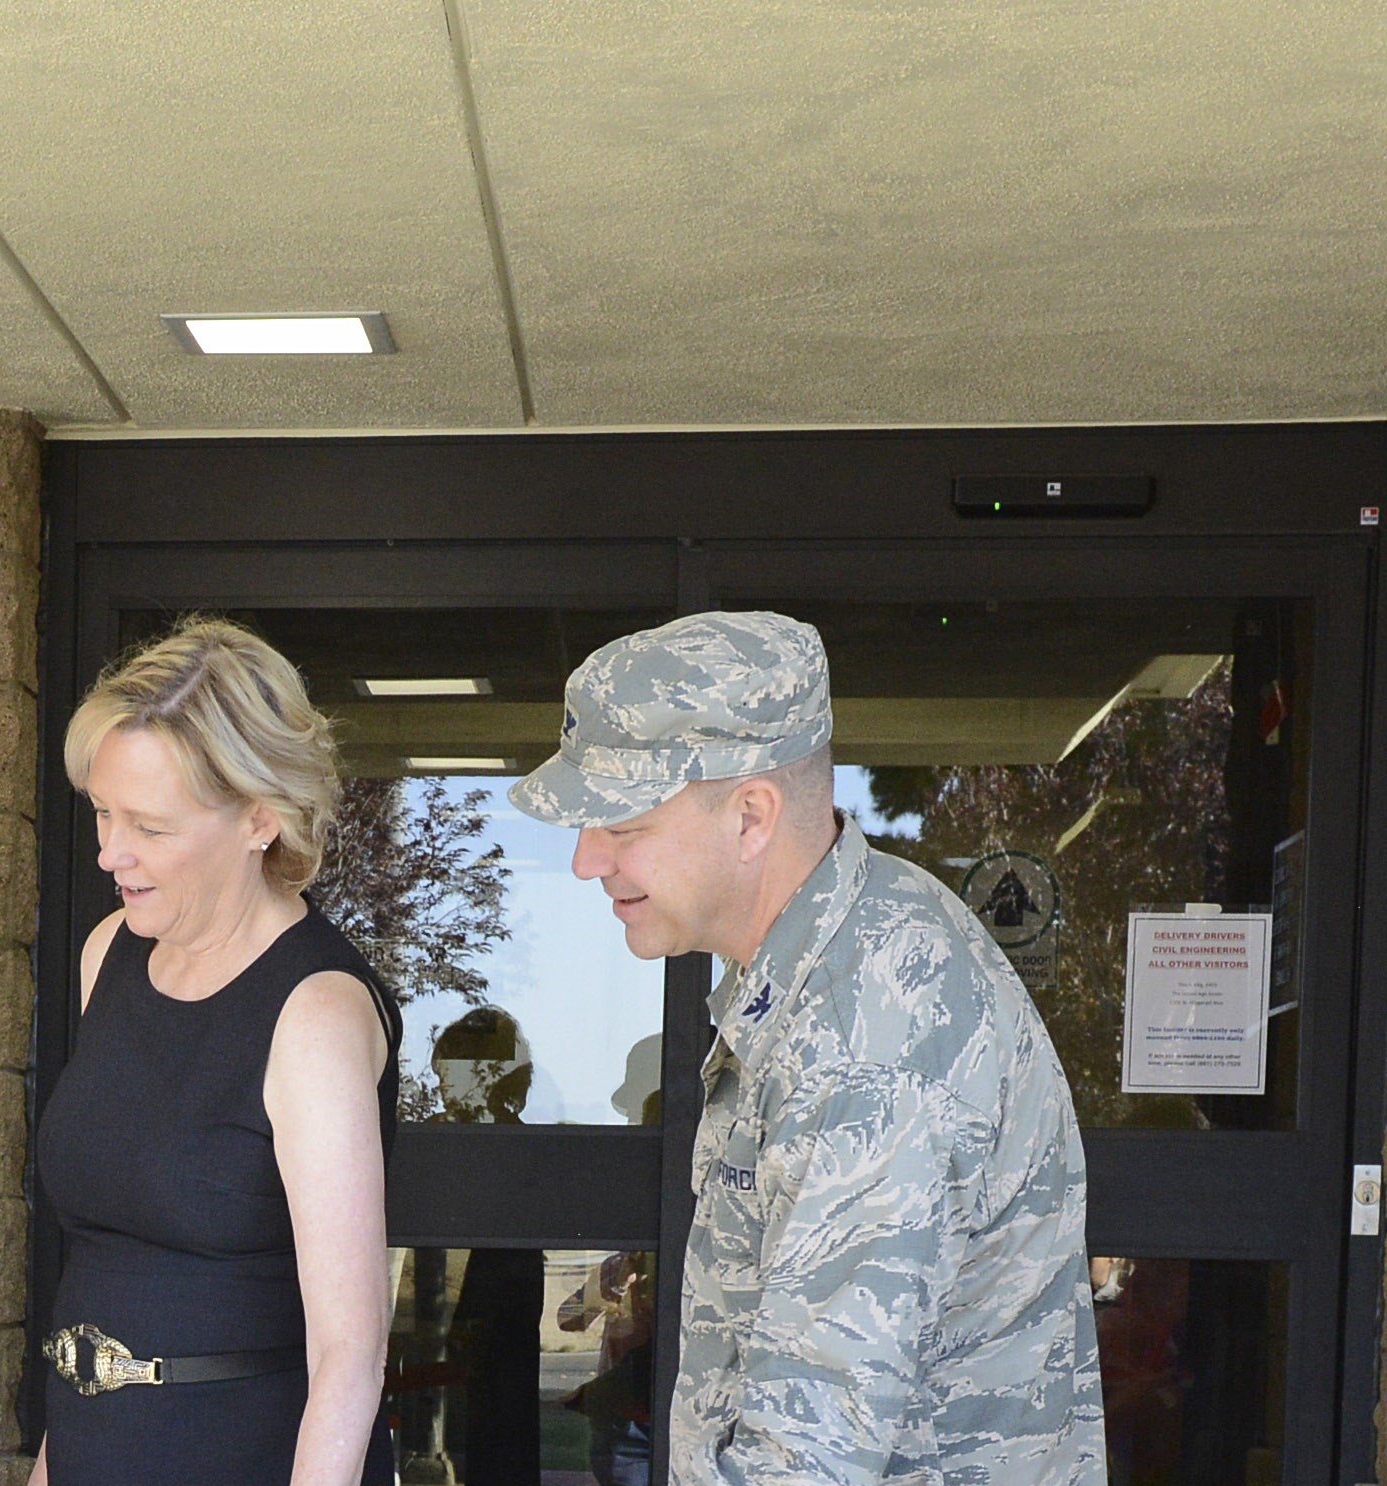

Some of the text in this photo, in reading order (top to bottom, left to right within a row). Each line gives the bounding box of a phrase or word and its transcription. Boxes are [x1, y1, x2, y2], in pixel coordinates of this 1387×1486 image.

[1154, 931, 1246, 940] DELIVERY DRIVERS
[1152, 946, 1247, 955] CIVIL ENGINEERING
[1022, 955, 1052, 965] DOOR
[1148, 960, 1249, 969] ALL OTHER VISITORS
[1018, 968, 1049, 978] VING
[717, 1158, 758, 1191] FORC
